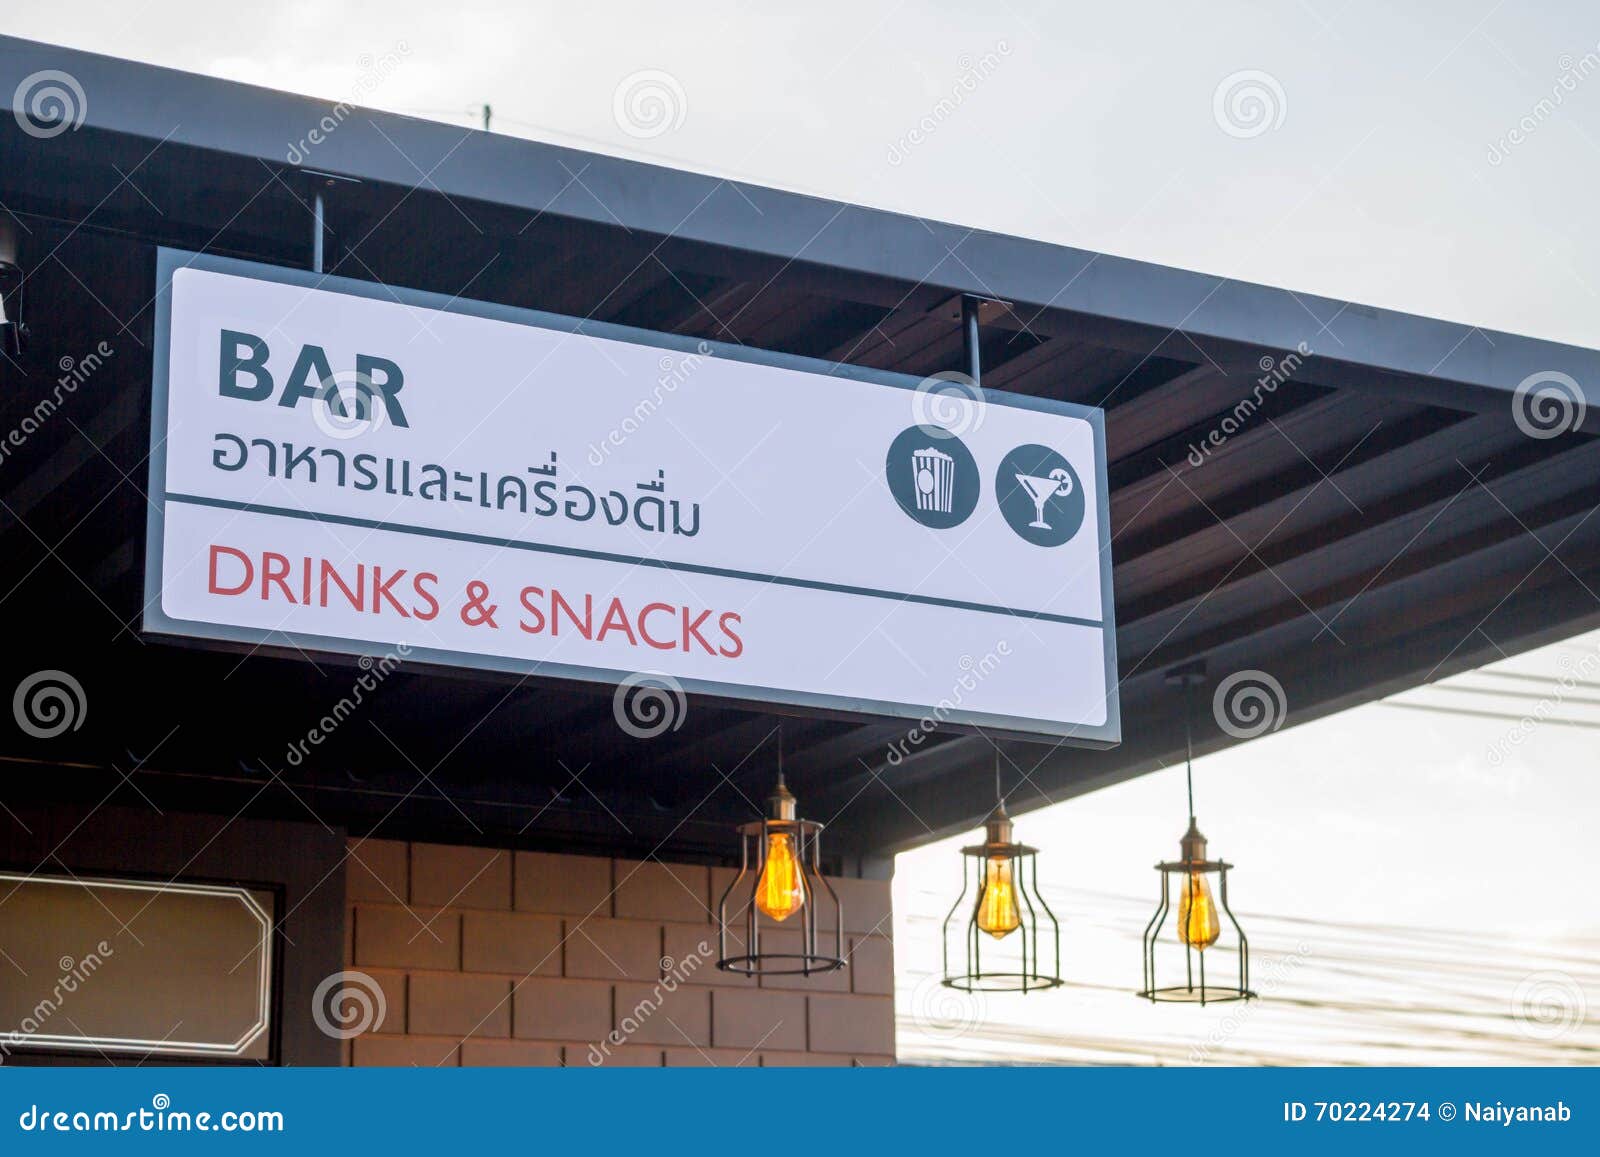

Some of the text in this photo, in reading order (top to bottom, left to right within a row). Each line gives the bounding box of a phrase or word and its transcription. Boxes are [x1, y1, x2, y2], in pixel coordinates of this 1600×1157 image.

[218, 329, 409, 428] BAR
[212, 433, 700, 537] อาหารและเครื่องดื่ม
[208, 544, 743, 659] DRINKS & SNACKS
